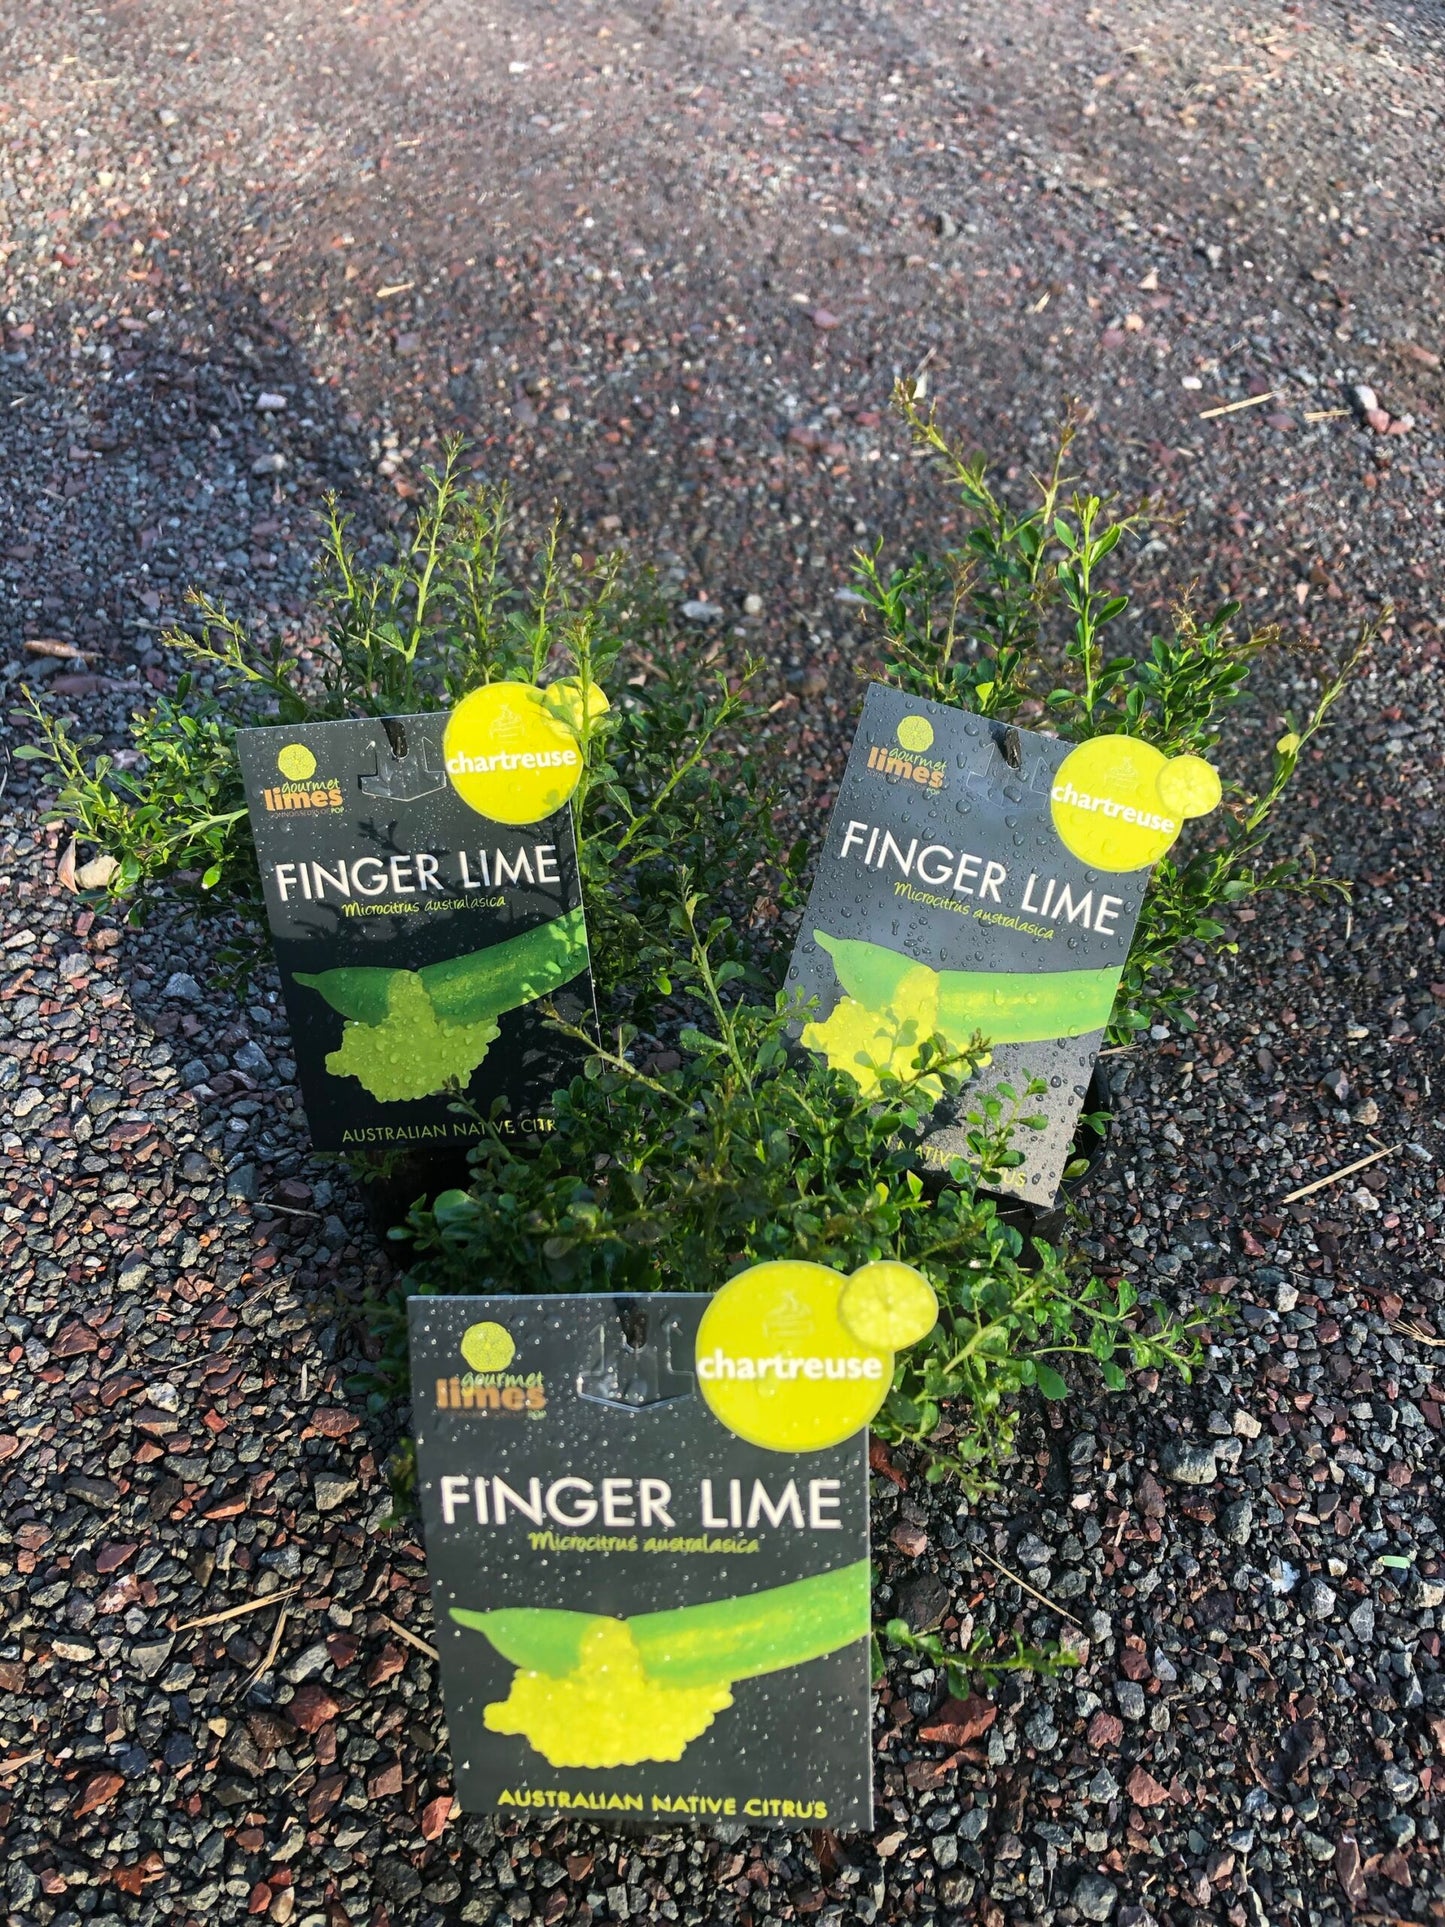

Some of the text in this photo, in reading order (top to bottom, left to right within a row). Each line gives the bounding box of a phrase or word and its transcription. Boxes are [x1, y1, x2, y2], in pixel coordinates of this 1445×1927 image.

[446, 746, 578, 776] chartreuse
[866, 745, 945, 789] limes
[888, 747, 947, 774] gourmet
[263, 786, 343, 812] limes
[281, 777, 341, 801] gourmet
[1050, 782, 1176, 834] chartreuse
[275, 844, 561, 901] FINGER LIME
[840, 820, 1123, 936] FINGER LIME
[342, 894, 506, 918] Microcitrus australasica
[894, 880, 1055, 941] Microcitrus australasica
[342, 1118, 558, 1143] AUSTRALIAN NATVE CITR
[697, 1348, 883, 1381] chartreuse
[436, 1377, 546, 1411] limes
[461, 1370, 544, 1398] gourmet
[440, 1475, 842, 1530] FINGER LIME
[528, 1531, 760, 1554] Microcitrus australasica
[497, 1788, 828, 1820] AUSTRALIAN NATIVE CITRUS
